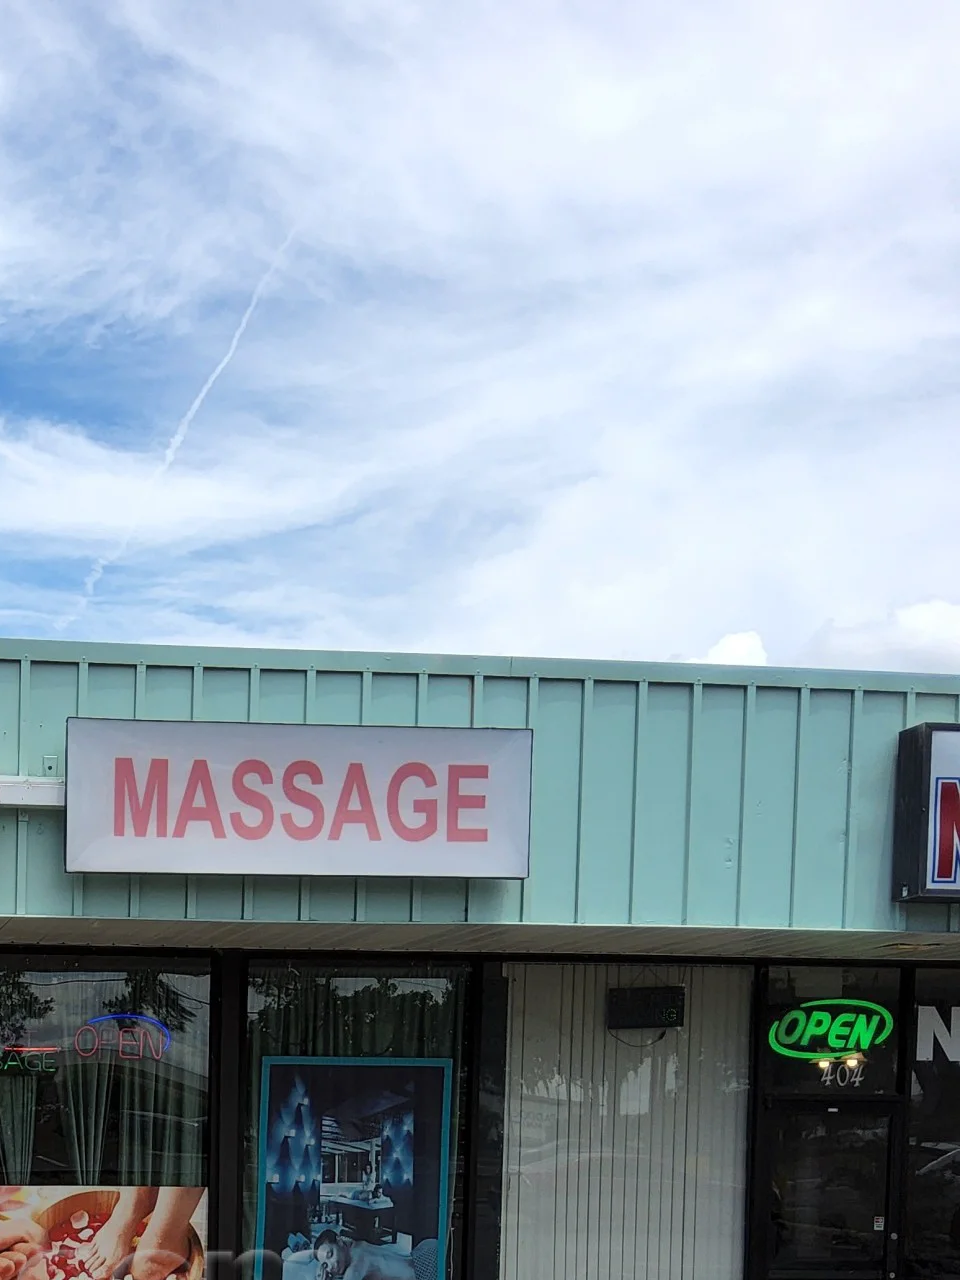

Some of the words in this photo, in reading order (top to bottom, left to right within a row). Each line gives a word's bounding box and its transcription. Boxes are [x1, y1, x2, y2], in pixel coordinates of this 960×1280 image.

[113, 757, 489, 843] MASSAGE
[74, 1025, 163, 1060] OPEN
[777, 1009, 881, 1050] OPEN
[821, 1065, 865, 1087] 404
